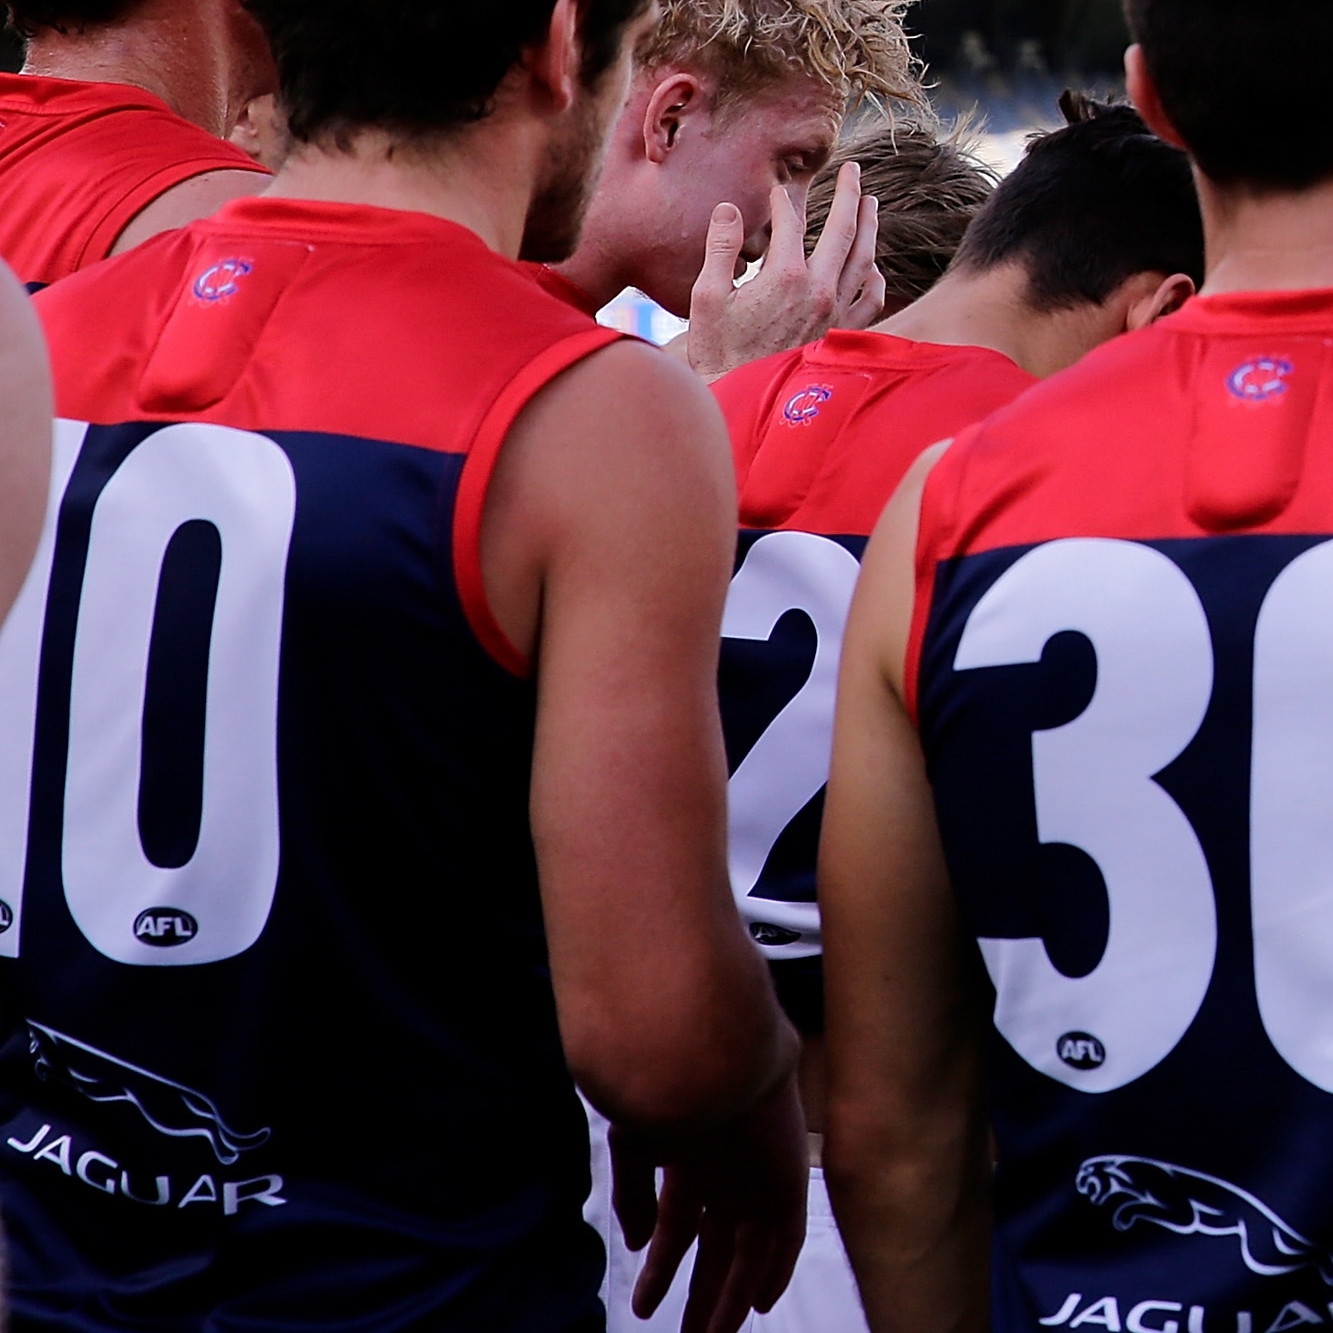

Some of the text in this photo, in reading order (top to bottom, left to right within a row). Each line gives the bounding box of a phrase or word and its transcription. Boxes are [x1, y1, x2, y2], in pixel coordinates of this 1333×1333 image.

[134, 915, 194, 938] AFL
[1059, 1038, 1103, 1064] AFL
[7, 1124, 287, 1215] JAGUAR
